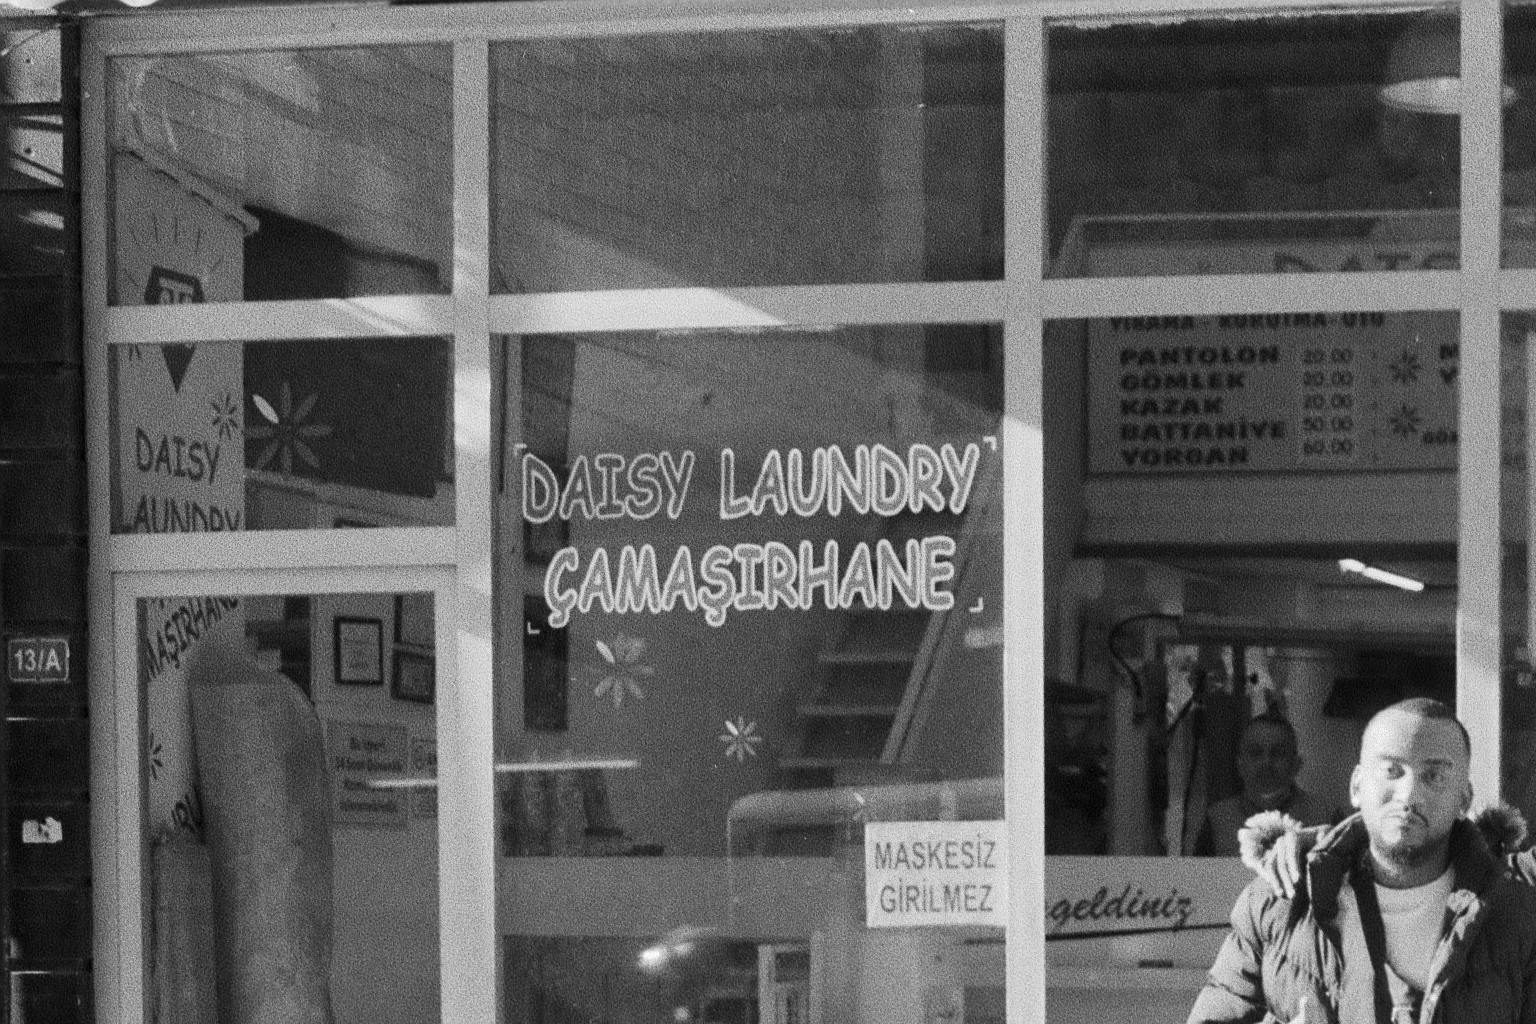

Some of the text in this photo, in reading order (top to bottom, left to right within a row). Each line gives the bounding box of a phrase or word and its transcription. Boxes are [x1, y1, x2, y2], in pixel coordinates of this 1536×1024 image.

[1119, 346, 1280, 366] PANTOLON
[1119, 397, 1223, 416] KAZAK
[136, 425, 221, 486] DAISY
[1120, 446, 1249, 467] YORGAN
[522, 442, 981, 523] DAISY LAUNDRY
[543, 535, 957, 628] ÇAMAŞIRHANE
[13, 648, 63, 673] 13/A
[874, 833, 997, 870] MASKESİZ
[879, 878, 994, 914] GİRİLMEZ
[1048, 884, 1194, 933] geldiniz
